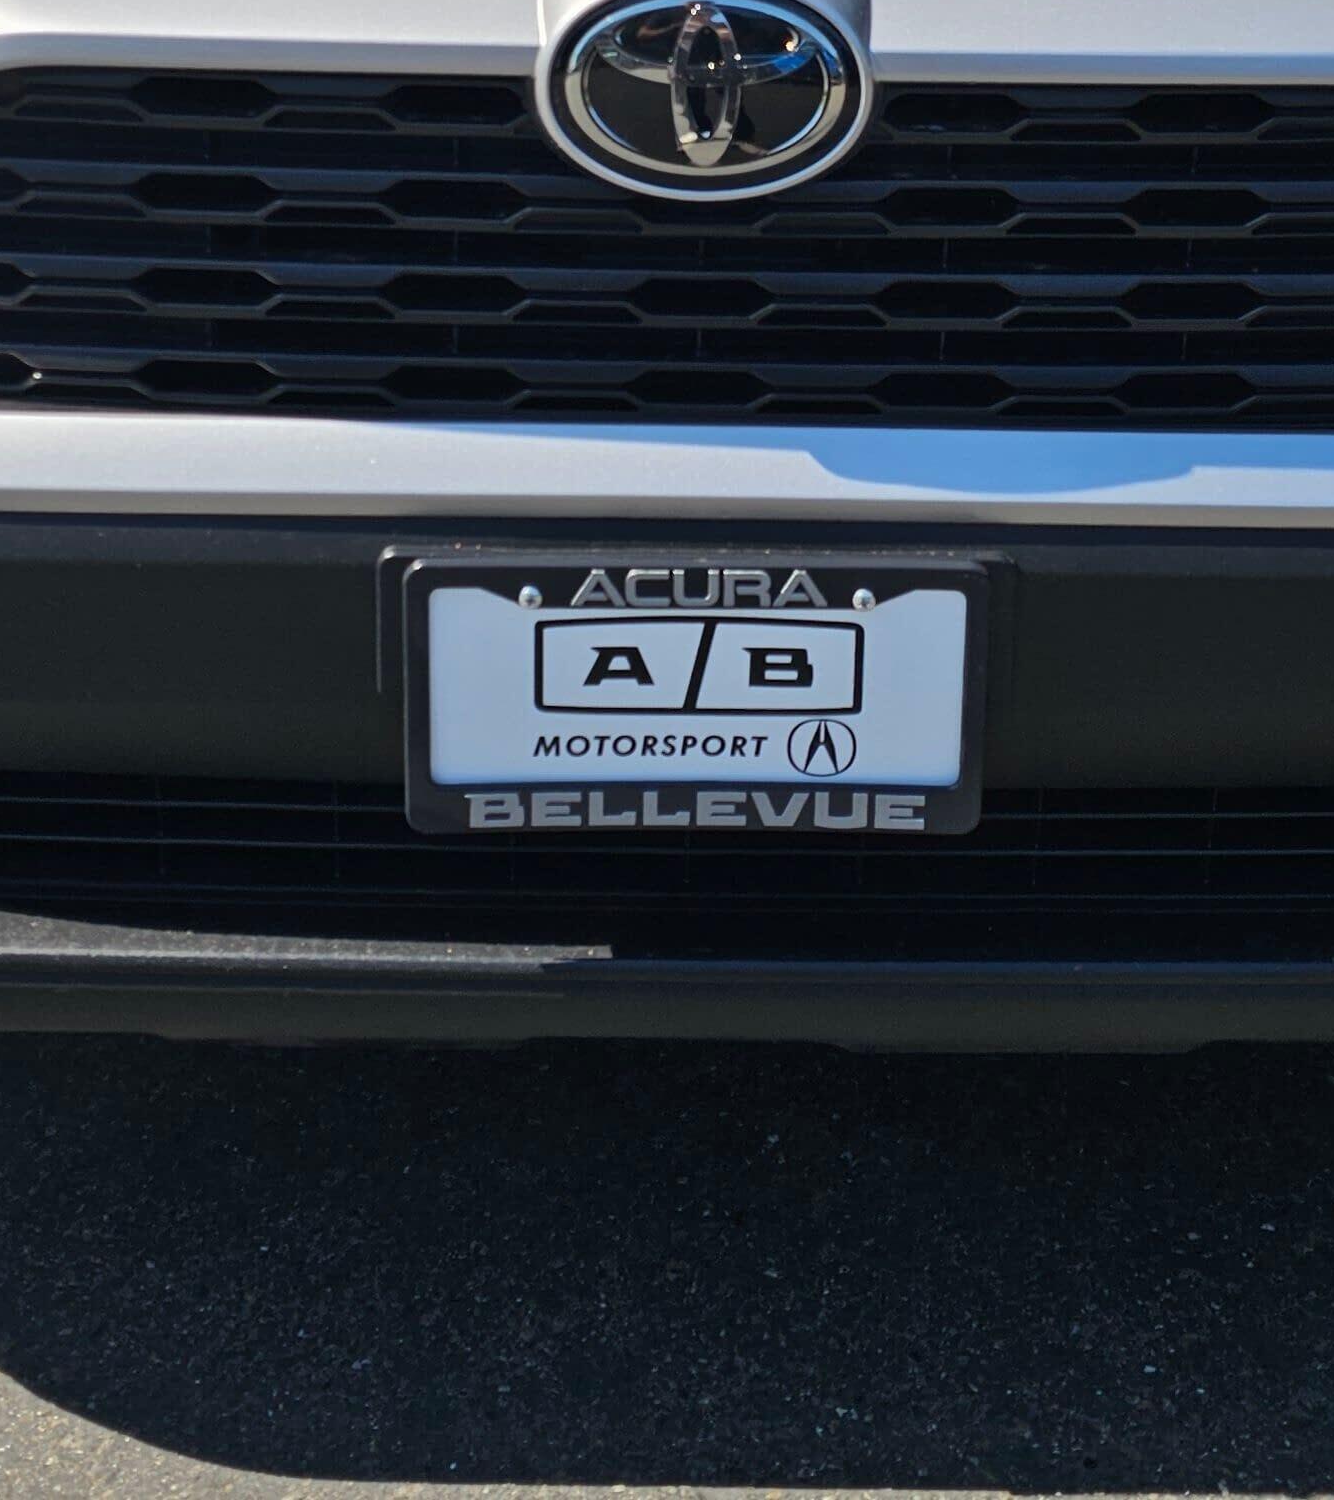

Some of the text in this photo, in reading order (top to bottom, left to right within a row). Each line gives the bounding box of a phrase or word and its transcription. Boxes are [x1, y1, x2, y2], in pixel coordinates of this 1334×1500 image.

[570, 568, 828, 608] ACURA
[533, 734, 769, 758] MOTORSPORT
[464, 791, 926, 830] BELLEVUE
